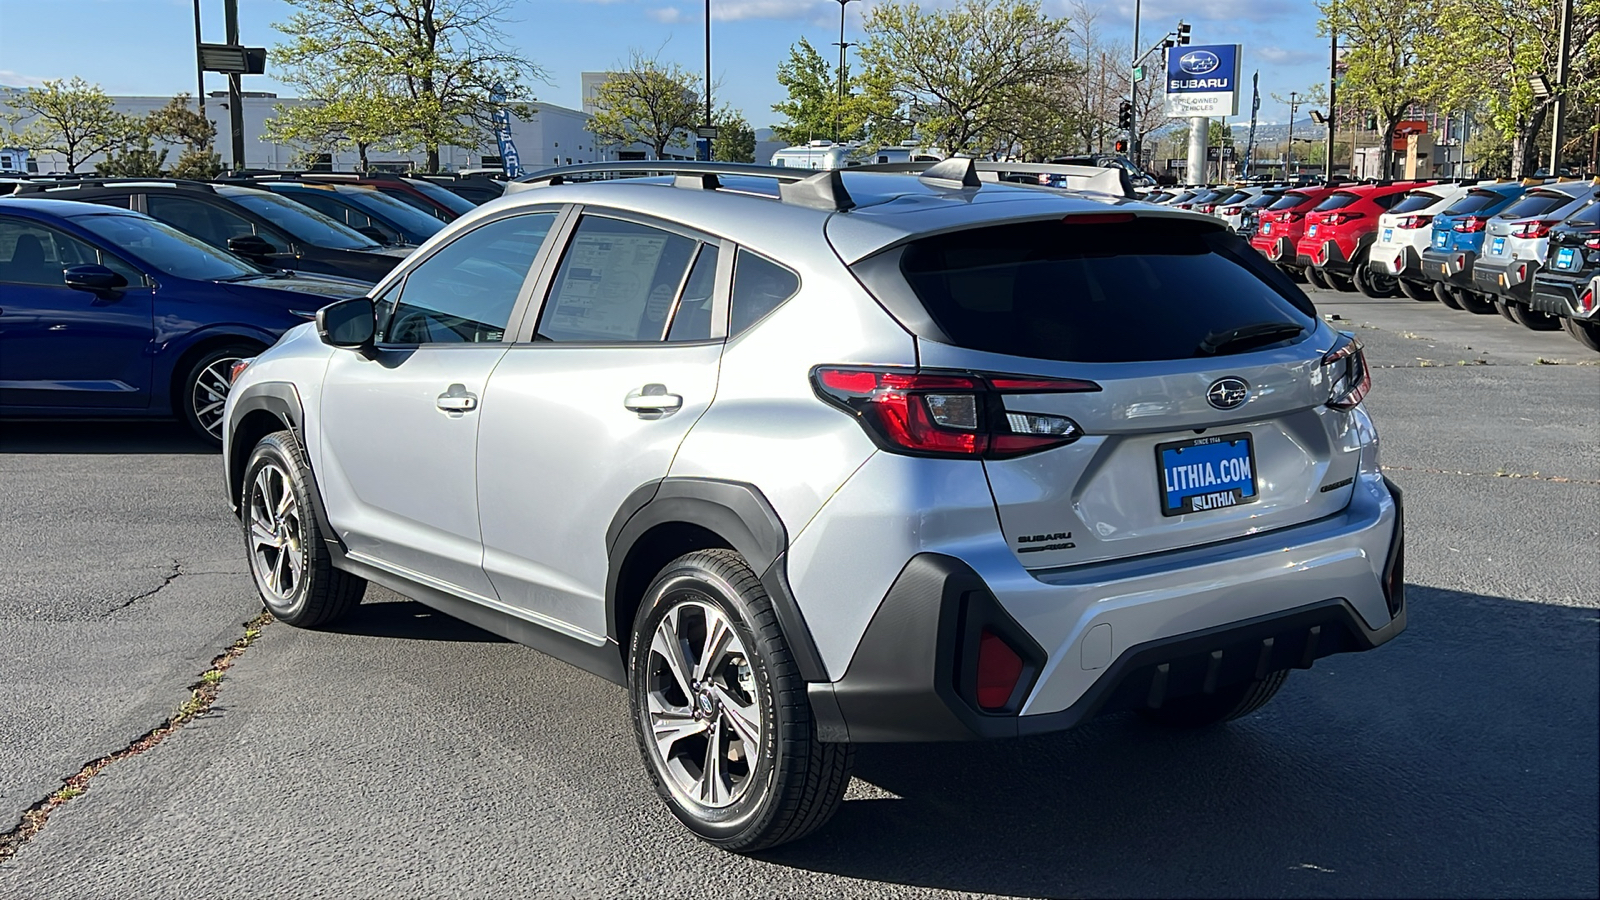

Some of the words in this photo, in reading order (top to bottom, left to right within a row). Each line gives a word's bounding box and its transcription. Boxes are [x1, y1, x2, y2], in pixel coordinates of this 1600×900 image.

[1170, 78, 1228, 89] SUBARU
[1194, 438, 1209, 446] SINCE
[1164, 456, 1252, 493] LITHIA.COM
[1202, 491, 1236, 510] LITHIA
[1018, 532, 1072, 543] SUBARU
